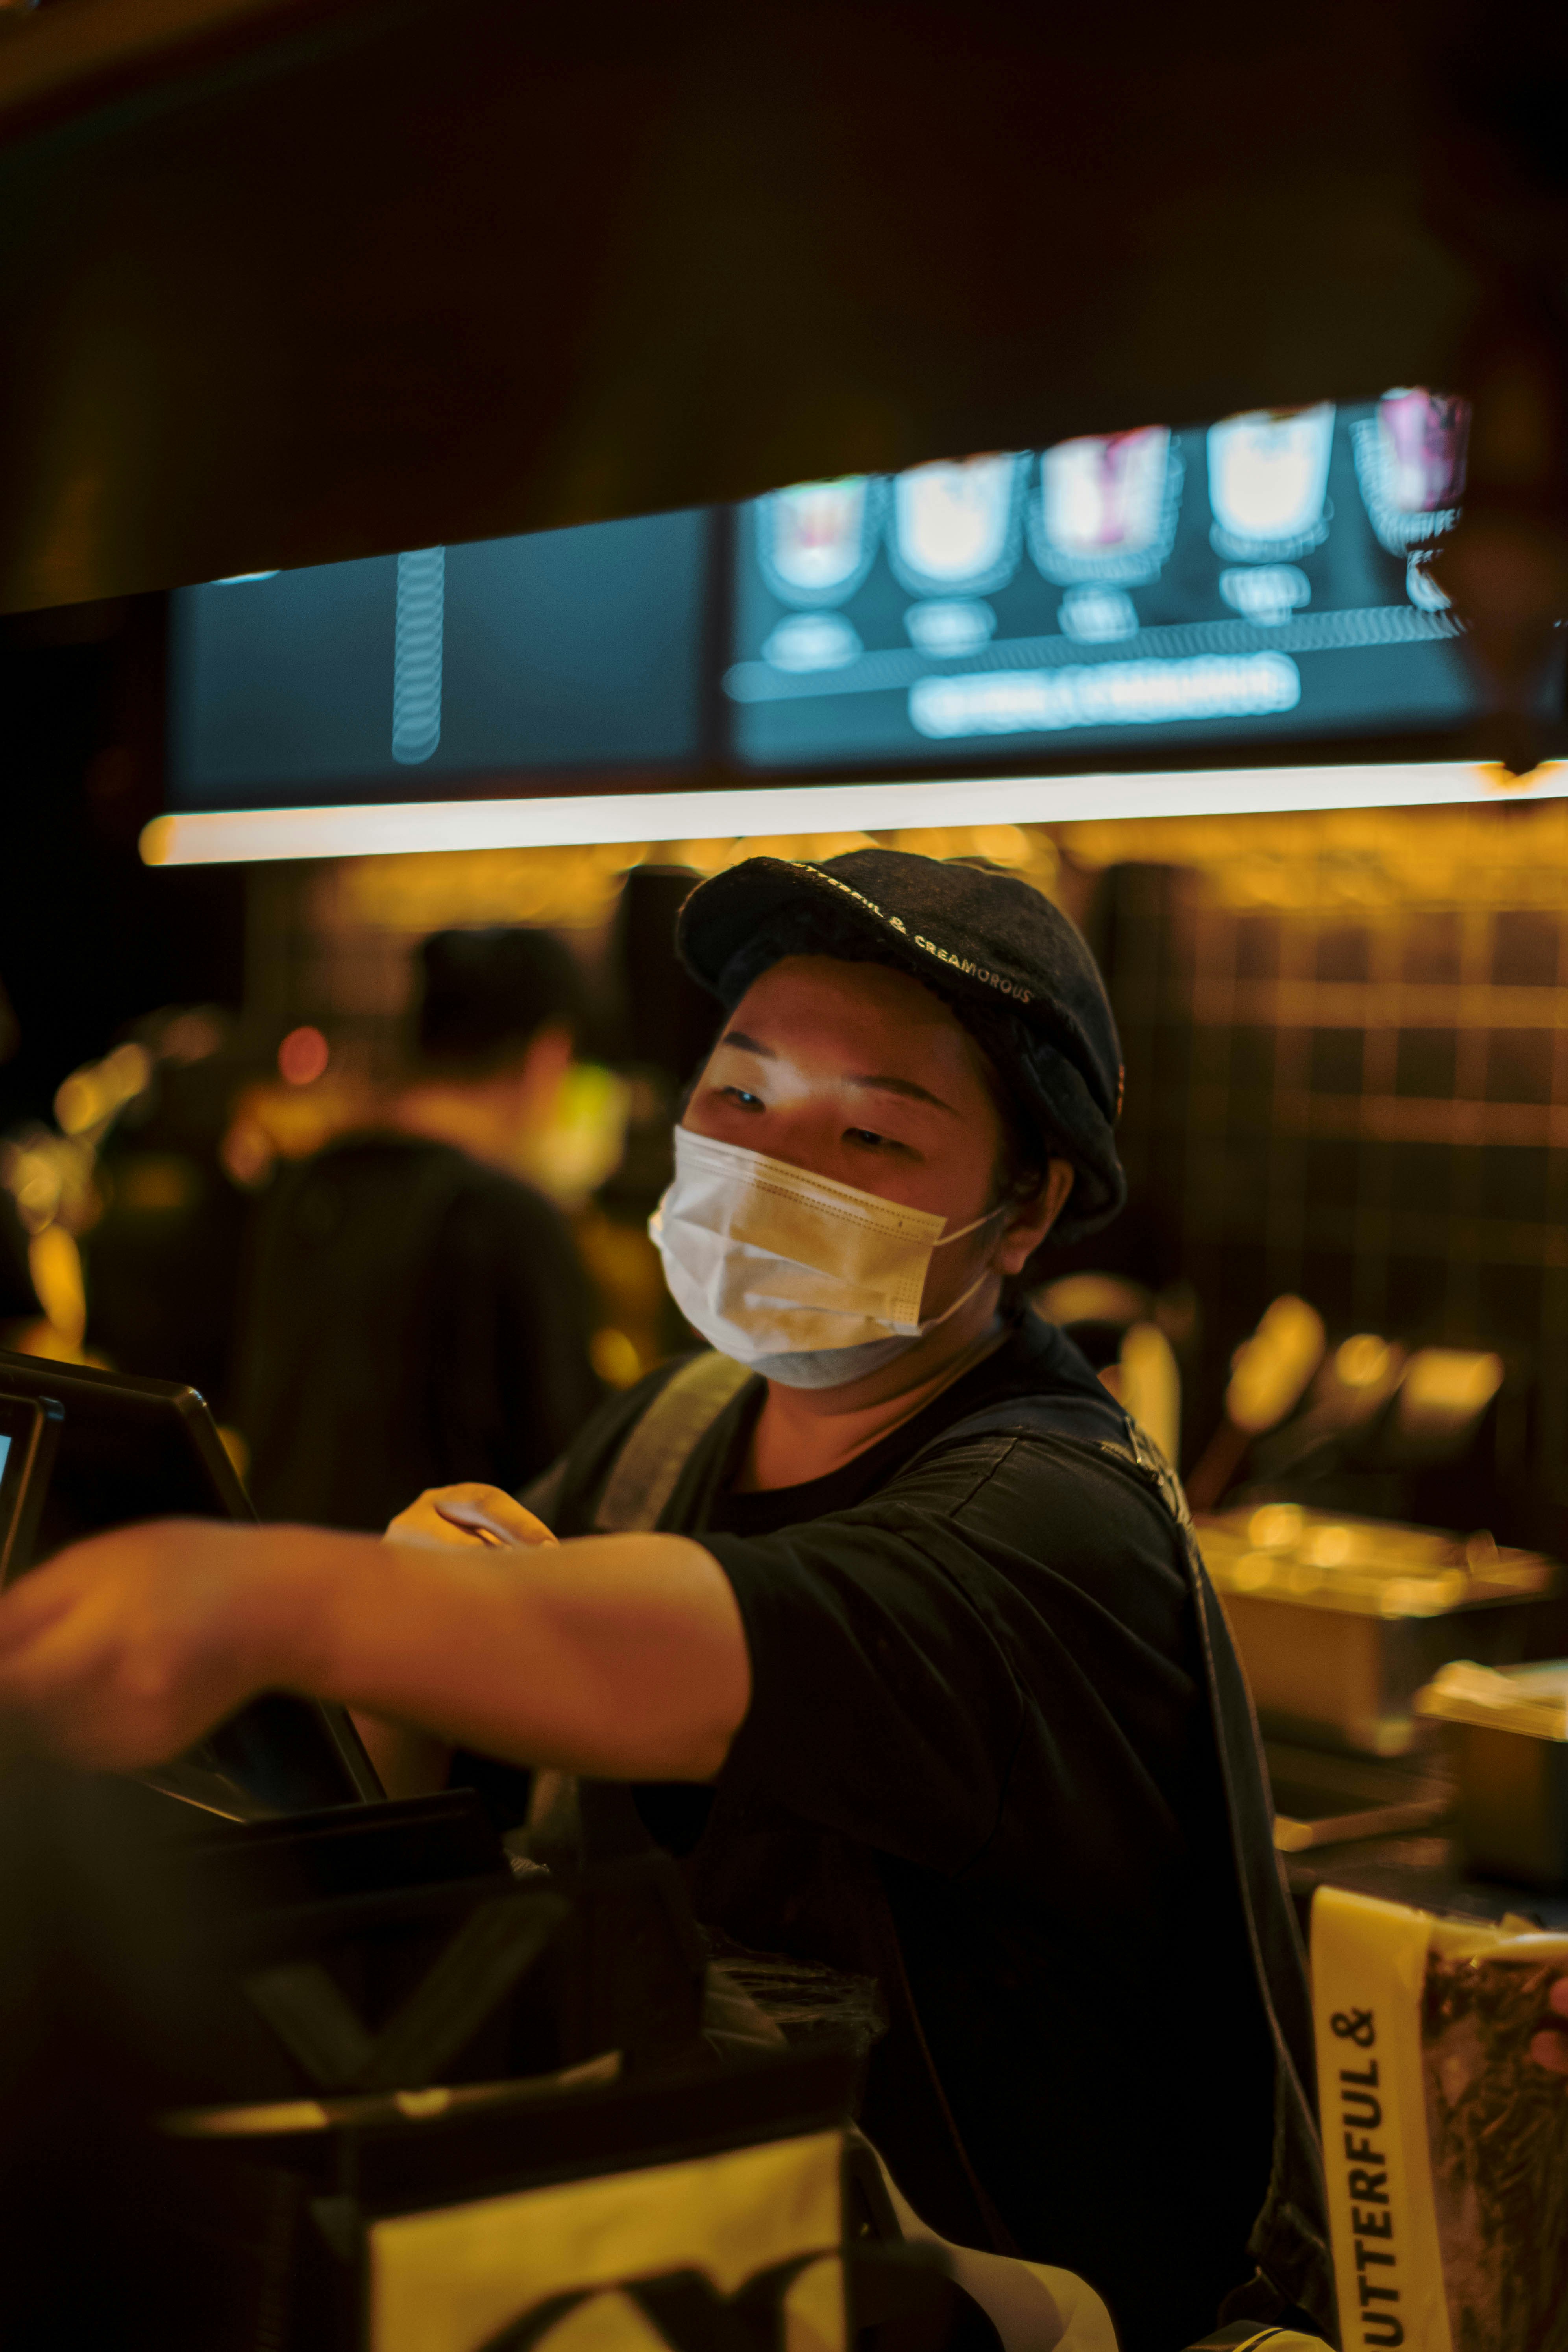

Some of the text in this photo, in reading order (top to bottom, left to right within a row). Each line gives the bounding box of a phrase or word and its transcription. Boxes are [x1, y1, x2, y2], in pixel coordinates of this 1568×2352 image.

[889, 916, 906, 934] &
[914, 935, 1035, 1003] CREAMOROUS
[1330, 2007, 1404, 2352] UTTERFUL &
